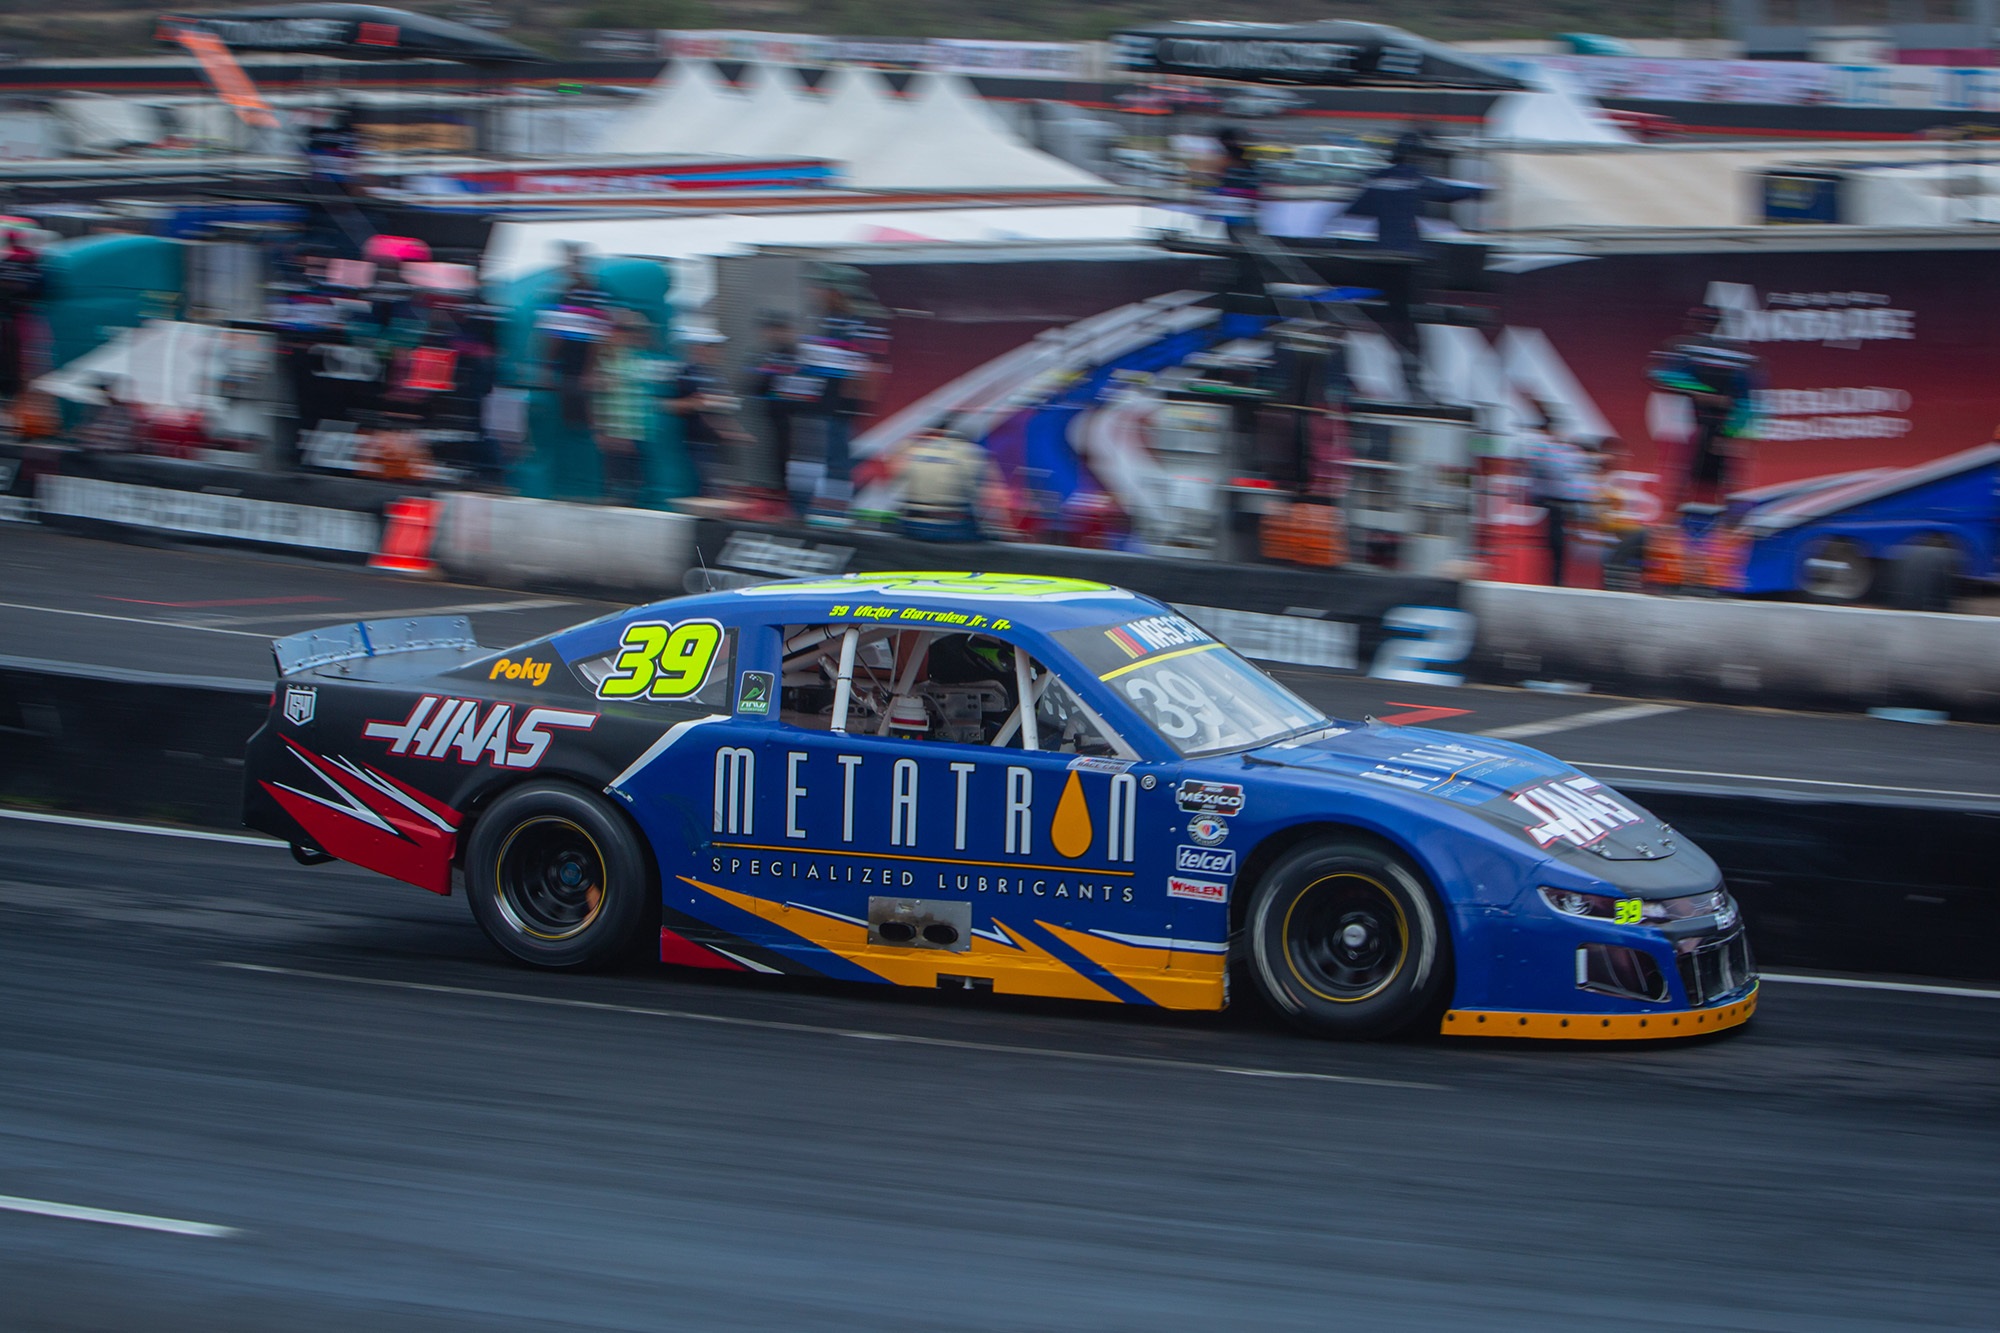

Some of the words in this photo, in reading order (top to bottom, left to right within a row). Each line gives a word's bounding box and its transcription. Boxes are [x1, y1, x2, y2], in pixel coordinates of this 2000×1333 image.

[829, 605, 849, 616] 39
[853, 605, 898, 620] Victor
[900, 607, 968, 624] Barrales
[966, 614, 988, 627] Jr.
[1126, 616, 1214, 650] NASCAR
[597, 619, 724, 700] 39
[1366, 604, 1477, 687] 2
[489, 657, 552, 686] Poky
[1126, 670, 1224, 739] 39
[362, 694, 600, 770] HAAS
[1179, 791, 1240, 806] MÉXICO
[1180, 850, 1232, 871] telcel
[712, 857, 914, 887] SPECIALIZED
[938, 872, 1134, 902] LUBRICANTS
[1613, 898, 1643, 925] 39
